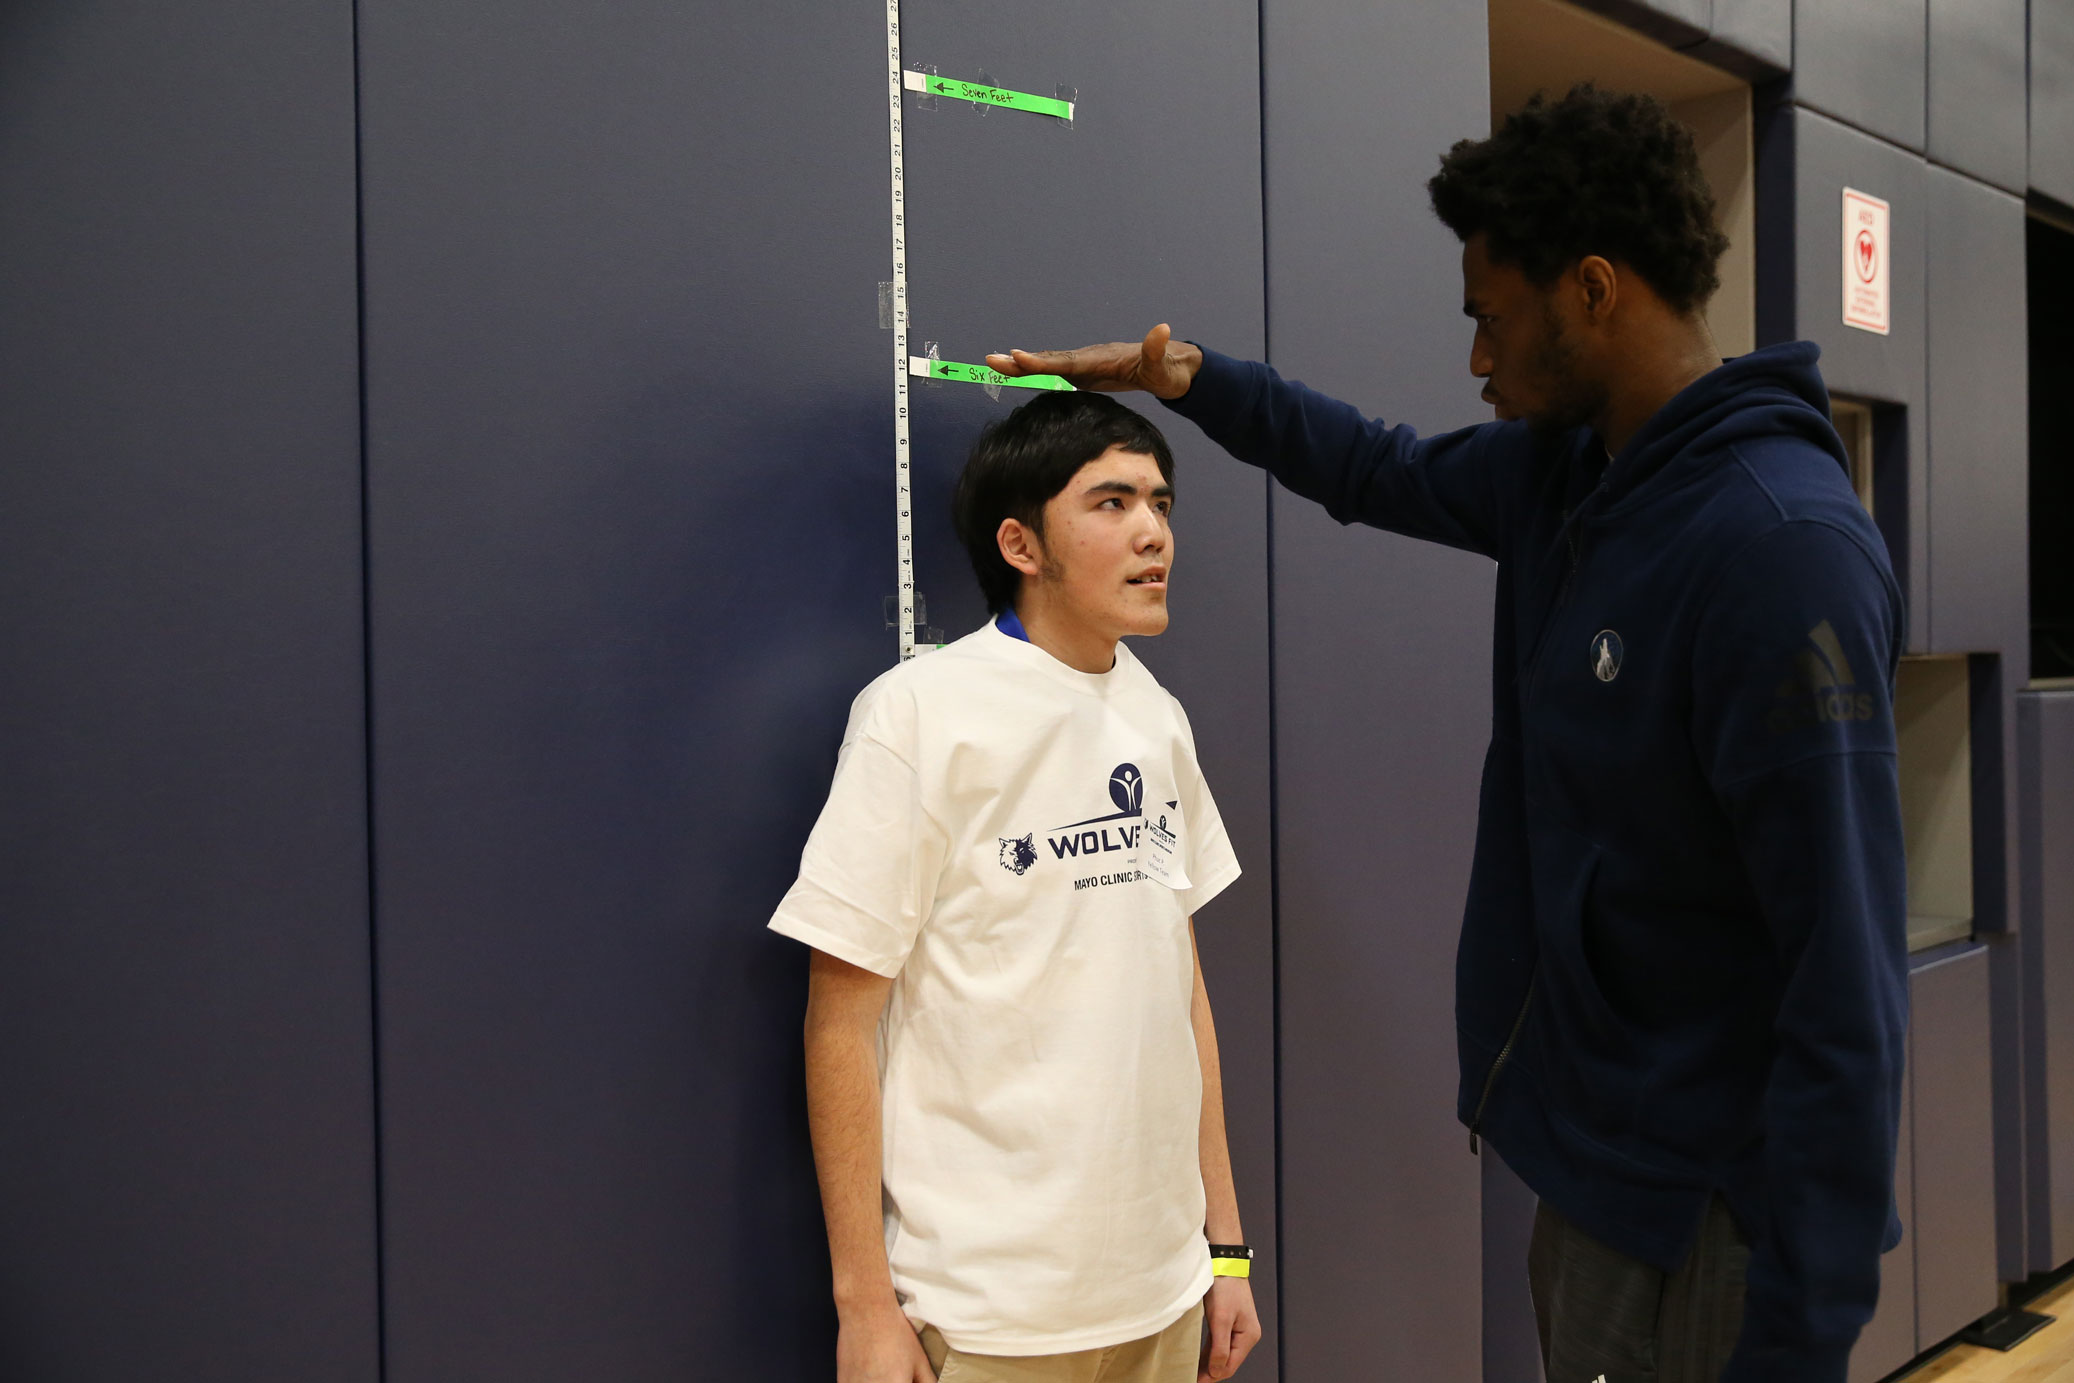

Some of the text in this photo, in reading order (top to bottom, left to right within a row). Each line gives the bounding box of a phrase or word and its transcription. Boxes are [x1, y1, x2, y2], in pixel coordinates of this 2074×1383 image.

[892, 22, 898, 37] 26
[892, 46, 898, 60] 25
[892, 70, 899, 84] 24
[961, 83, 1014, 103] Seven Feet
[892, 94, 899, 109] 23
[894, 118, 900, 132] 22
[894, 143, 901, 156] 21
[894, 166, 901, 181] 20
[896, 190, 902, 203] 19
[896, 214, 902, 228] 18
[896, 238, 903, 252] 17
[898, 262, 904, 276] 16
[898, 286, 904, 300] 15
[898, 310, 905, 324] 14
[898, 334, 905, 348] 13
[898, 358, 906, 373] 12
[968, 367, 1011, 384] Six Feet
[898, 384, 906, 396] 11
[900, 407, 907, 421] 10
[900, 438, 908, 446] 9
[902, 462, 908, 470] 8
[902, 510, 909, 518] 6
[902, 534, 910, 542] 5
[904, 582, 911, 590] 3
[904, 607, 912, 615] 2
[1150, 825, 1168, 843] WOLVES
[1168, 838, 1176, 847] FIT
[1074, 876, 1098, 891] MAYO
[1100, 871, 1133, 886] CLINIC
